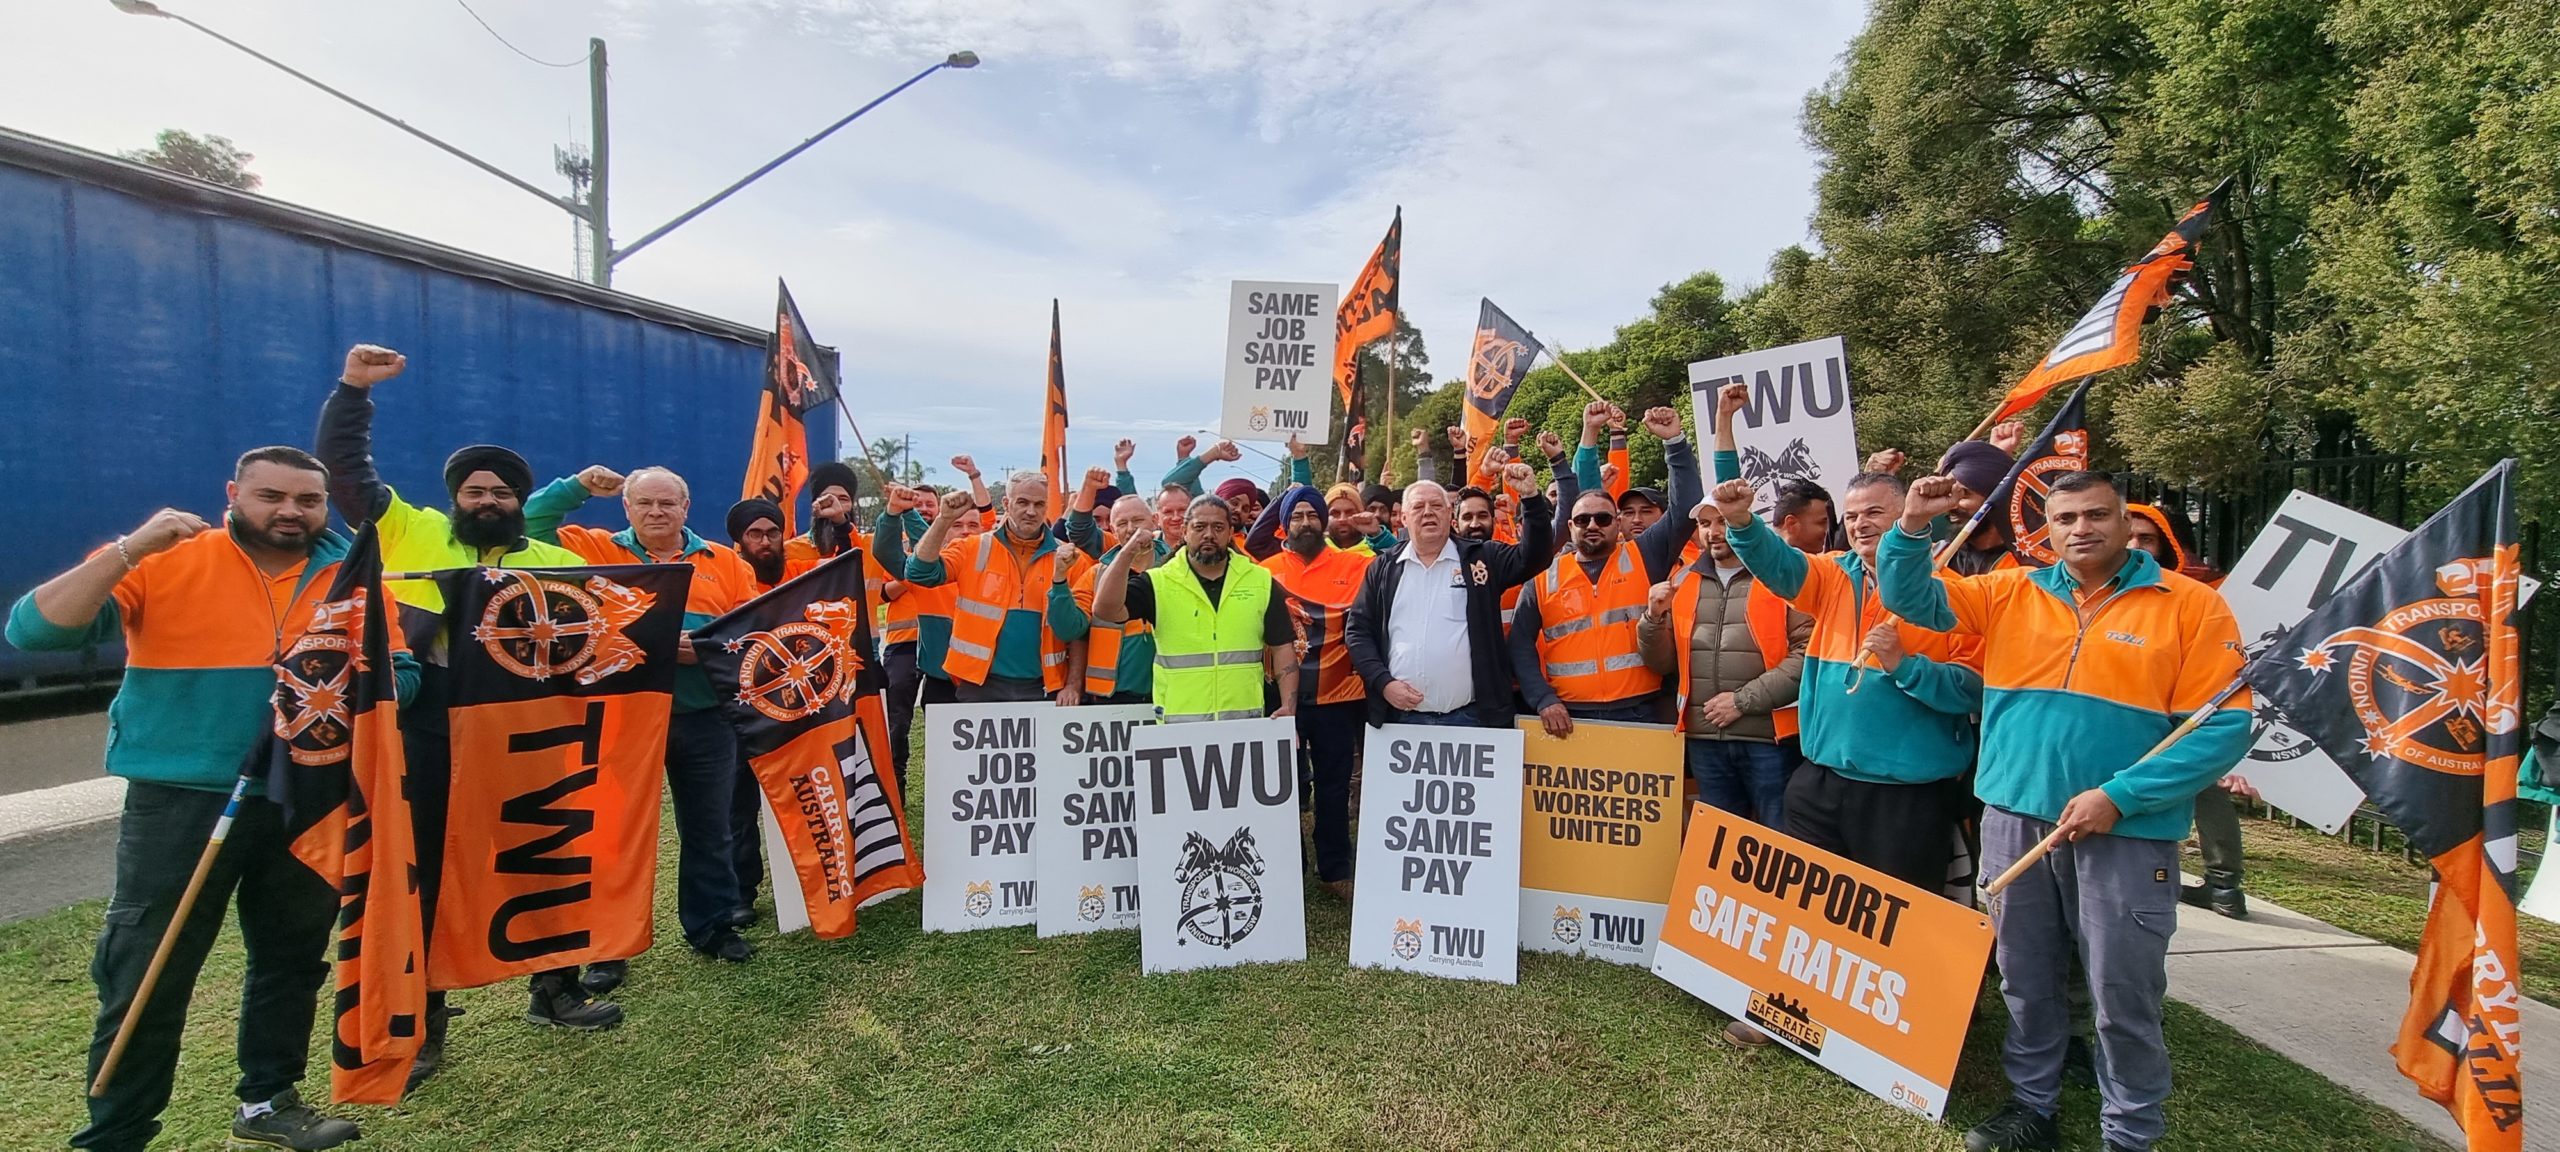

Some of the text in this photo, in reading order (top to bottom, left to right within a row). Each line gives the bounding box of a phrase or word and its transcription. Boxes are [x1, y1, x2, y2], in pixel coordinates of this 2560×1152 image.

[1248, 292, 1319, 316] SAME
[1257, 318, 1305, 341] JOB
[1244, 342, 1315, 366] SAME
[1255, 367, 1302, 391] PAY
[1692, 357, 1844, 435] TWU
[1273, 409, 1309, 429] TWU
[2031, 459, 2081, 475] TRANSPO
[2011, 482, 2024, 522] UNION
[488, 584, 523, 613] UNION
[544, 582, 600, 616] TRANSPORT
[775, 625, 832, 641] TRANSPORT
[2383, 603, 2484, 632] TRANSPO
[2105, 630, 2146, 647] TOLL
[741, 644, 763, 678] UNION
[2351, 648, 2372, 708] UNION
[767, 706, 802, 719] AUSTRALIA
[952, 717, 1036, 750] SAM
[1062, 720, 1157, 754] SAM
[967, 752, 1036, 785] JOB
[1389, 740, 1495, 778] SAME
[2271, 747, 2301, 760] NSW
[2404, 748, 2484, 770] OF AUSTRAL
[1135, 739, 1293, 815] TWU
[1523, 763, 1675, 797] TRANSPORT
[952, 786, 1036, 822] SAM
[1403, 779, 1476, 816] JOB
[1533, 790, 1661, 823] WORKERS
[488, 701, 605, 962] TWU
[789, 774, 841, 904] AUSTRALIA
[810, 766, 854, 898] CARRYING
[970, 822, 1036, 857] PAY
[1385, 816, 1492, 857] SAME
[1550, 816, 1641, 847] UNITED
[1183, 868, 1209, 911] TRANSPORT
[1402, 856, 1472, 896] PAY
[1708, 825, 1910, 948] I SUPPORT
[1000, 880, 1037, 908] TW
[1112, 885, 1140, 912] TW
[1000, 907, 1023, 916] Carrying
[1242, 914, 1259, 934] NSW
[1186, 921, 1212, 944] UNION
[1430, 925, 1485, 959] TWU
[1590, 912, 1645, 946] TWU
[1428, 955, 1484, 967] Carrying Australia
[1588, 940, 1644, 953] Carrying Australia
[1690, 885, 1911, 1035] SAFE RATES.
[1751, 999, 1821, 1045] SAFE RATES
[1763, 1021, 1780, 1034] SAVE
[1907, 1090, 1928, 1109] TWU
